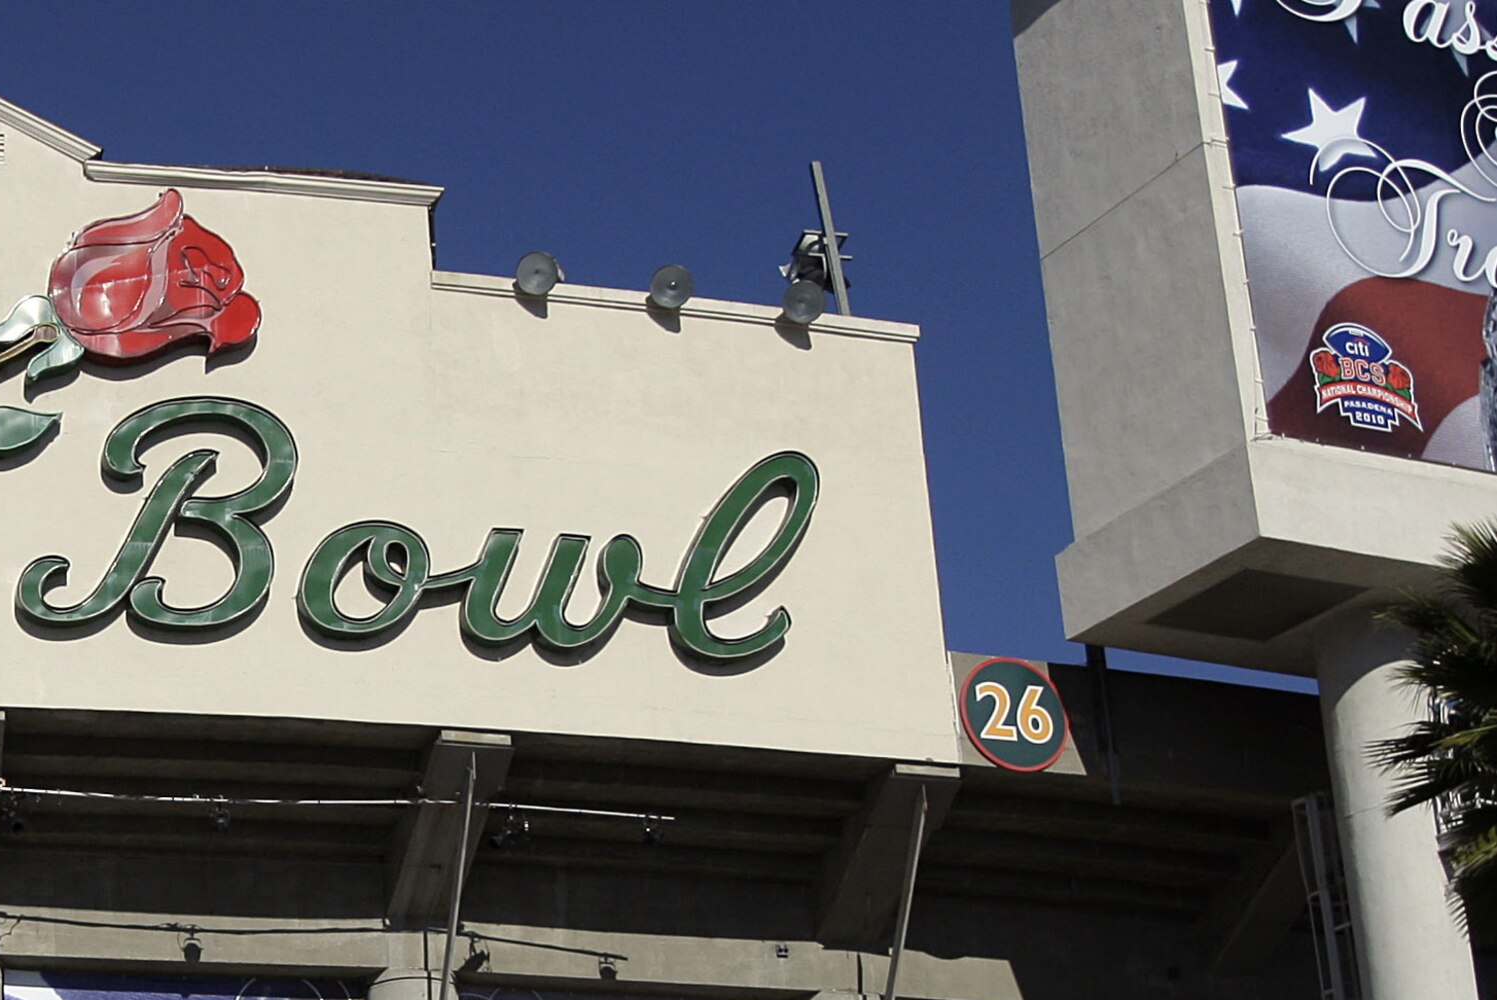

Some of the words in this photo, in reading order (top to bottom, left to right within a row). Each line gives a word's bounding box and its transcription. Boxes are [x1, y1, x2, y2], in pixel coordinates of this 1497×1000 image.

[1345, 341, 1370, 357] citi
[1338, 356, 1386, 386] BCS
[1344, 400, 1394, 417] PASADENA
[1355, 411, 1386, 425] 2010
[14, 395, 821, 666] Bowl
[975, 681, 1054, 745] 26
